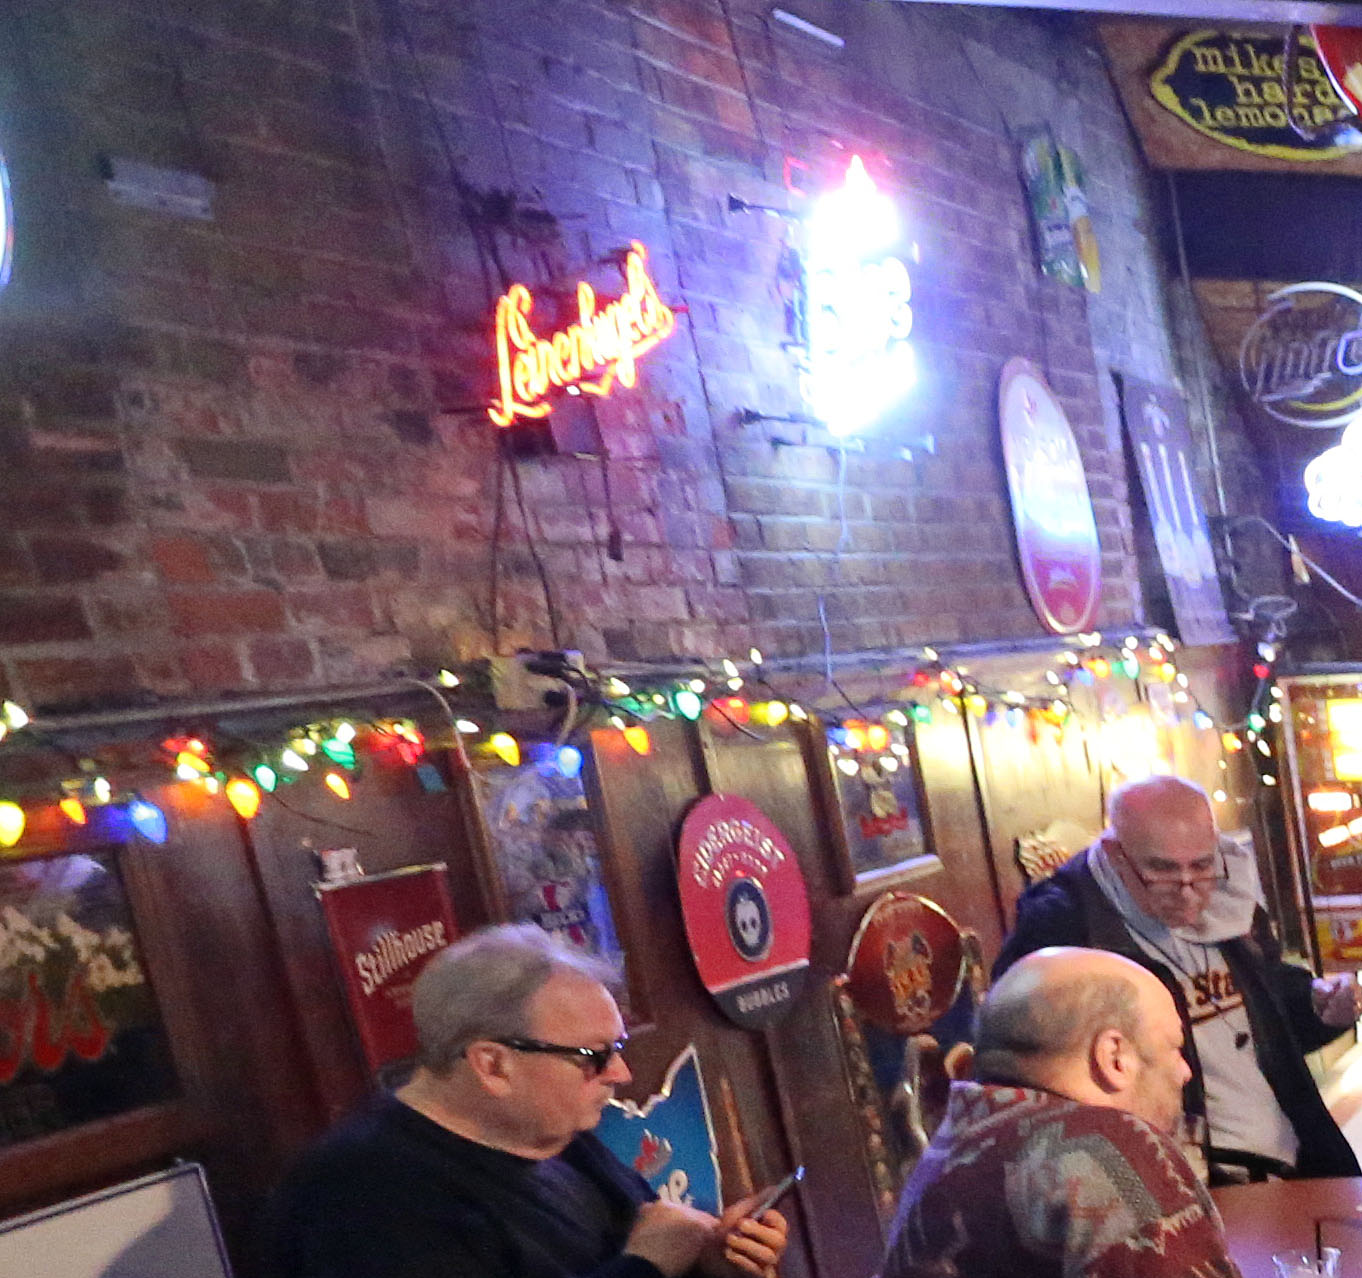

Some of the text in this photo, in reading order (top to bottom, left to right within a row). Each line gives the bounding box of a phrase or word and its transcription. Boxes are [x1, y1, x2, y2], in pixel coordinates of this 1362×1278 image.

[1193, 42, 1321, 81] mikes
[1227, 74, 1343, 105] hard
[1190, 95, 1352, 128] lemona
[355, 920, 449, 997] Stillhouse
[735, 980, 791, 1014] BUBBLES
